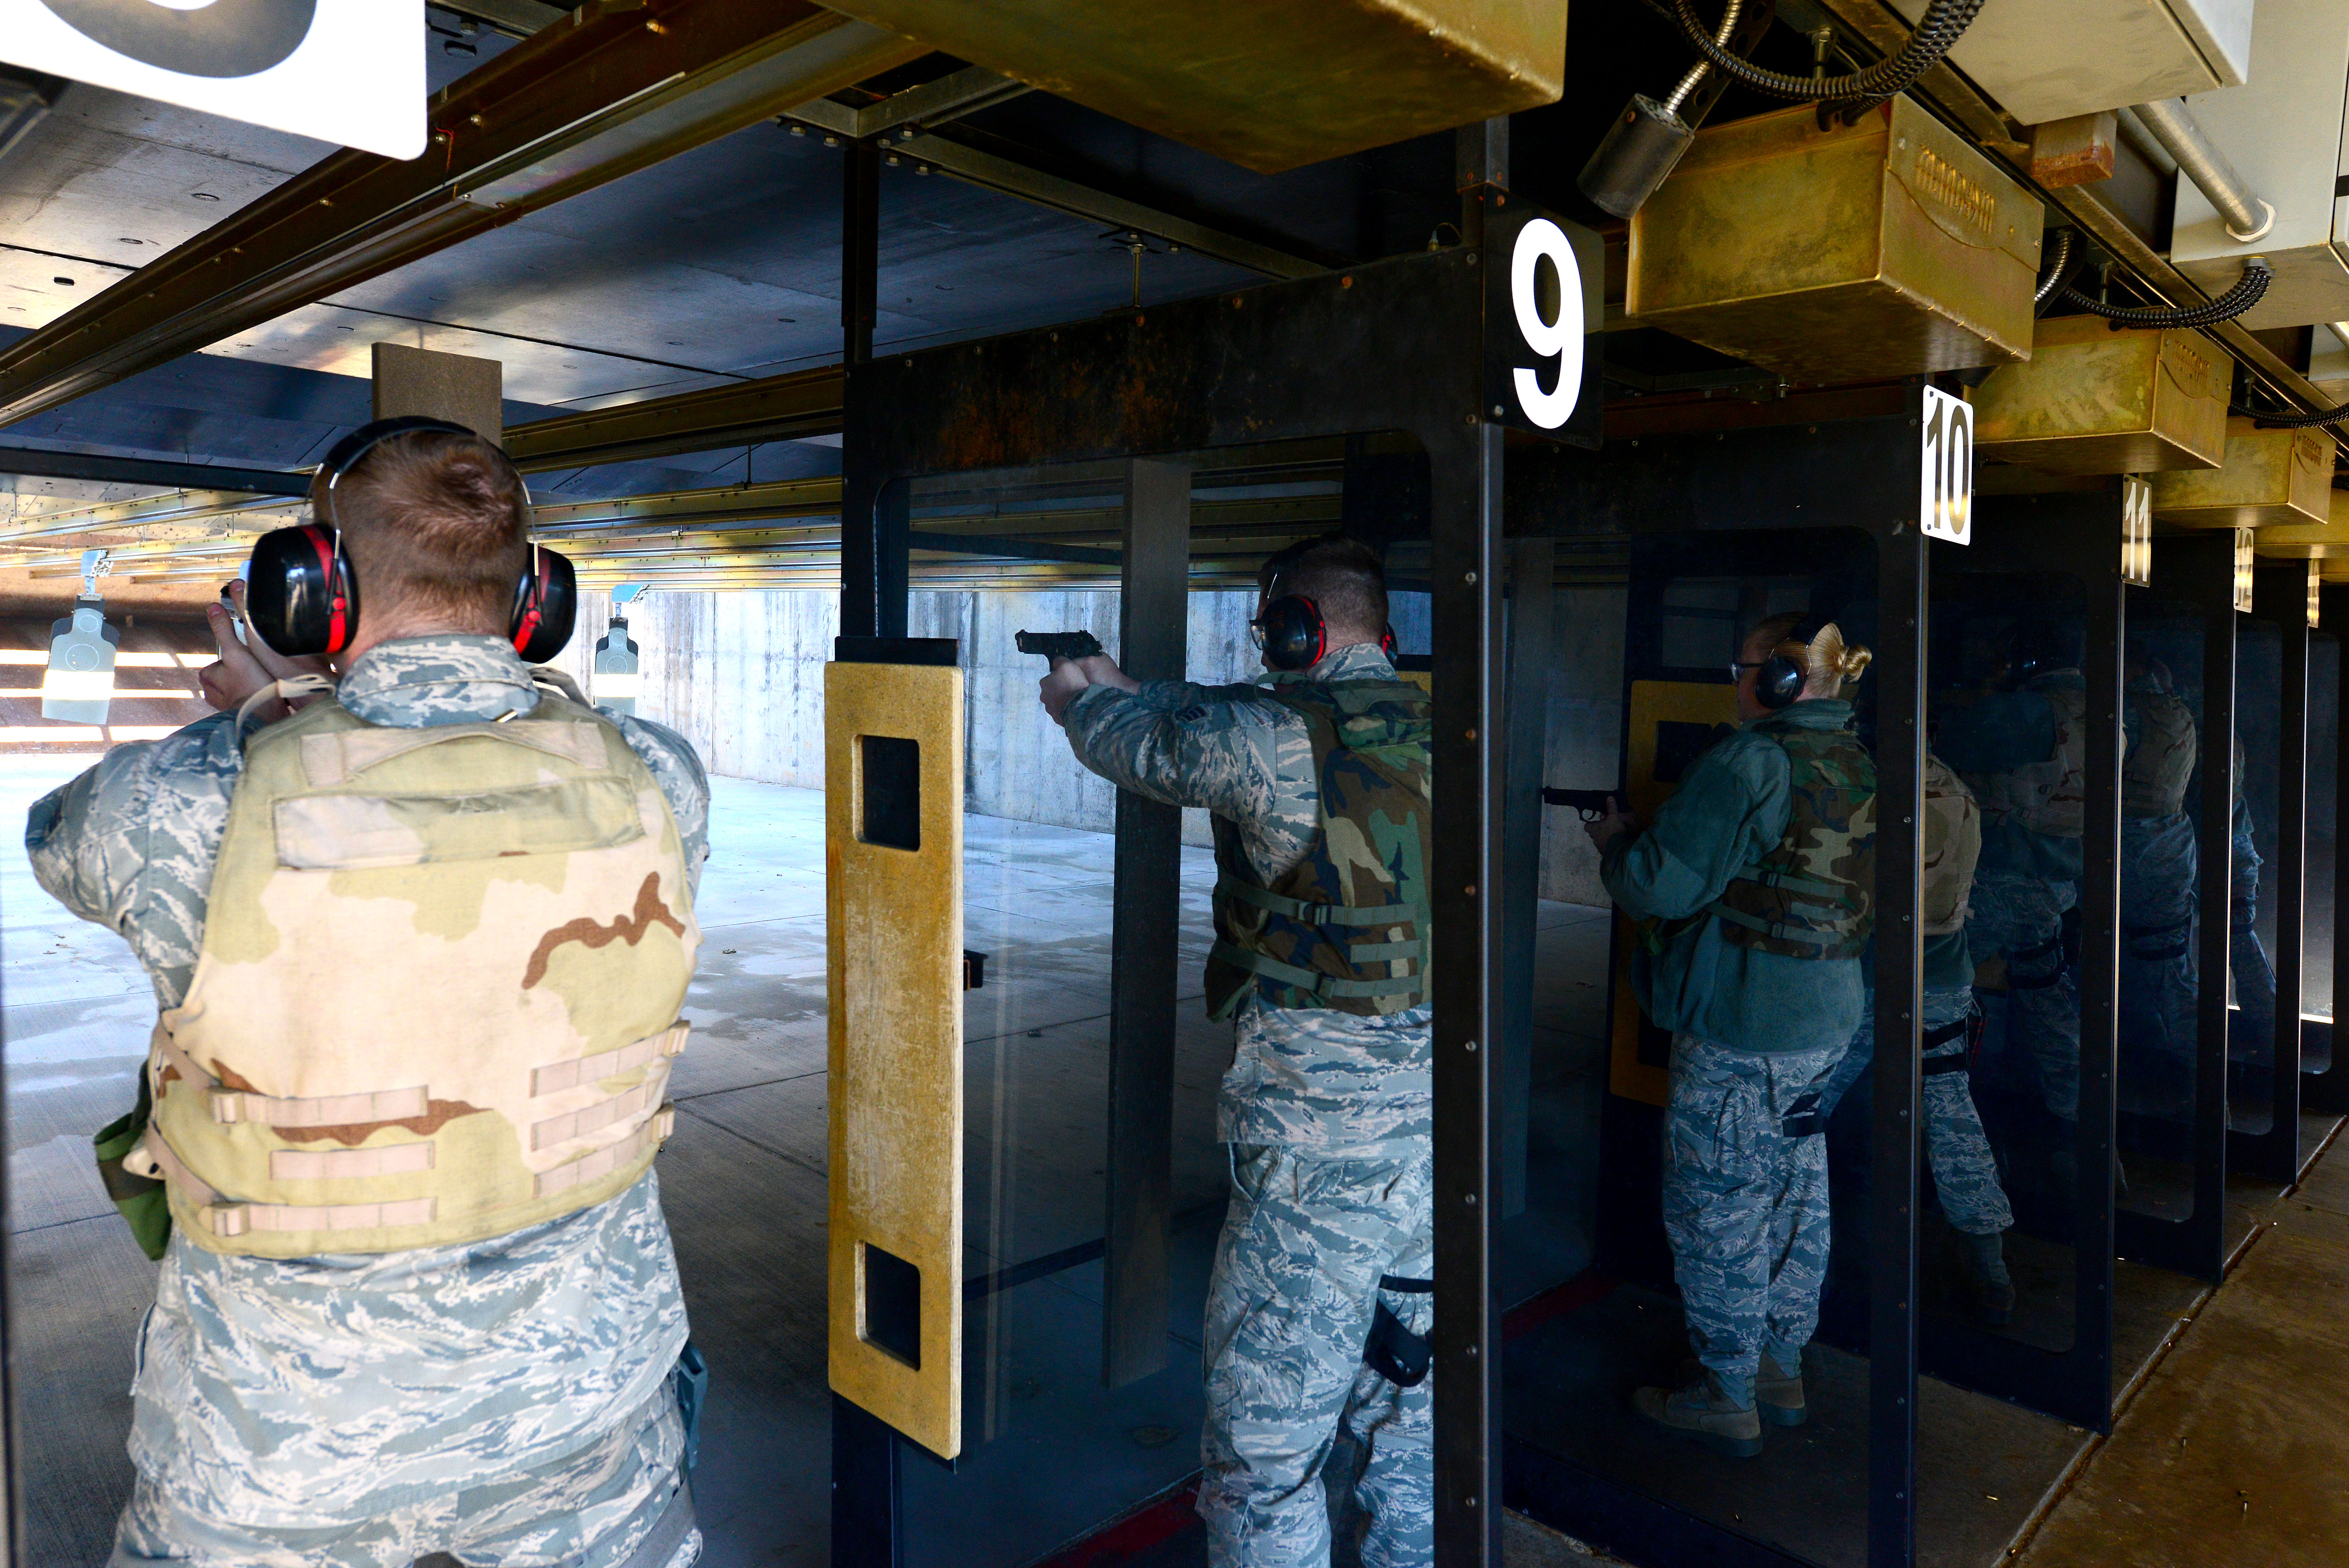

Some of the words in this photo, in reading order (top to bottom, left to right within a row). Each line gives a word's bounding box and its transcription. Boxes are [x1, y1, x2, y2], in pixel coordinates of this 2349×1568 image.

[1511, 218, 1584, 429] 9
[1927, 397, 1969, 535] 10
[2126, 482, 2148, 582] 11
[2236, 530, 2252, 608] 12
